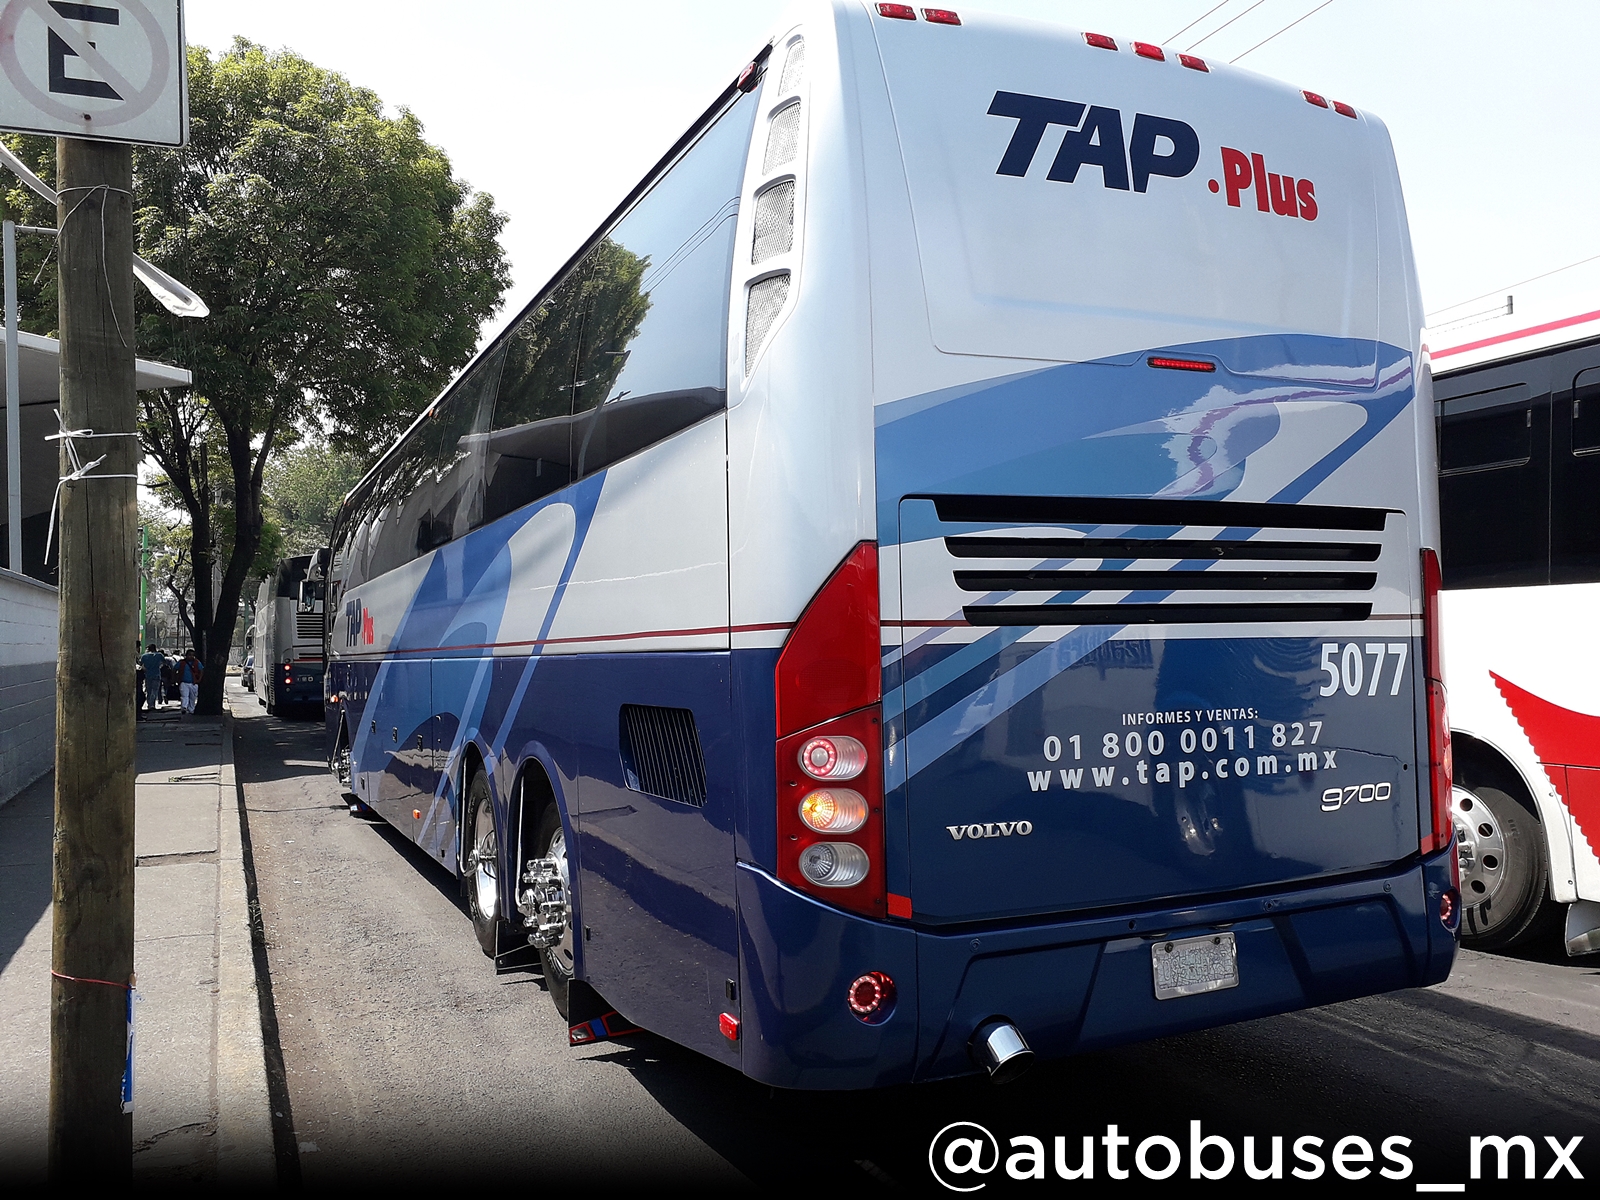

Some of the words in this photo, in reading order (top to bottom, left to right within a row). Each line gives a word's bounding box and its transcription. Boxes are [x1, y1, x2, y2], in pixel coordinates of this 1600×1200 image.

[986, 90, 1201, 193] TAP
[345, 598, 361, 647] TAP
[1319, 643, 1408, 698] 5077
[1121, 711, 1192, 727] INFORMES
[1195, 710, 1203, 722] Y
[1206, 707, 1259, 722] VENTAS:
[1043, 734, 1082, 762] 01
[1102, 729, 1165, 759] 800
[1179, 726, 1256, 755] 0011
[1272, 721, 1323, 747] 827
[1027, 748, 1338, 792] www.tap.com.mx
[1320, 782, 1392, 813] 9700
[946, 820, 1034, 841] VOLVO
